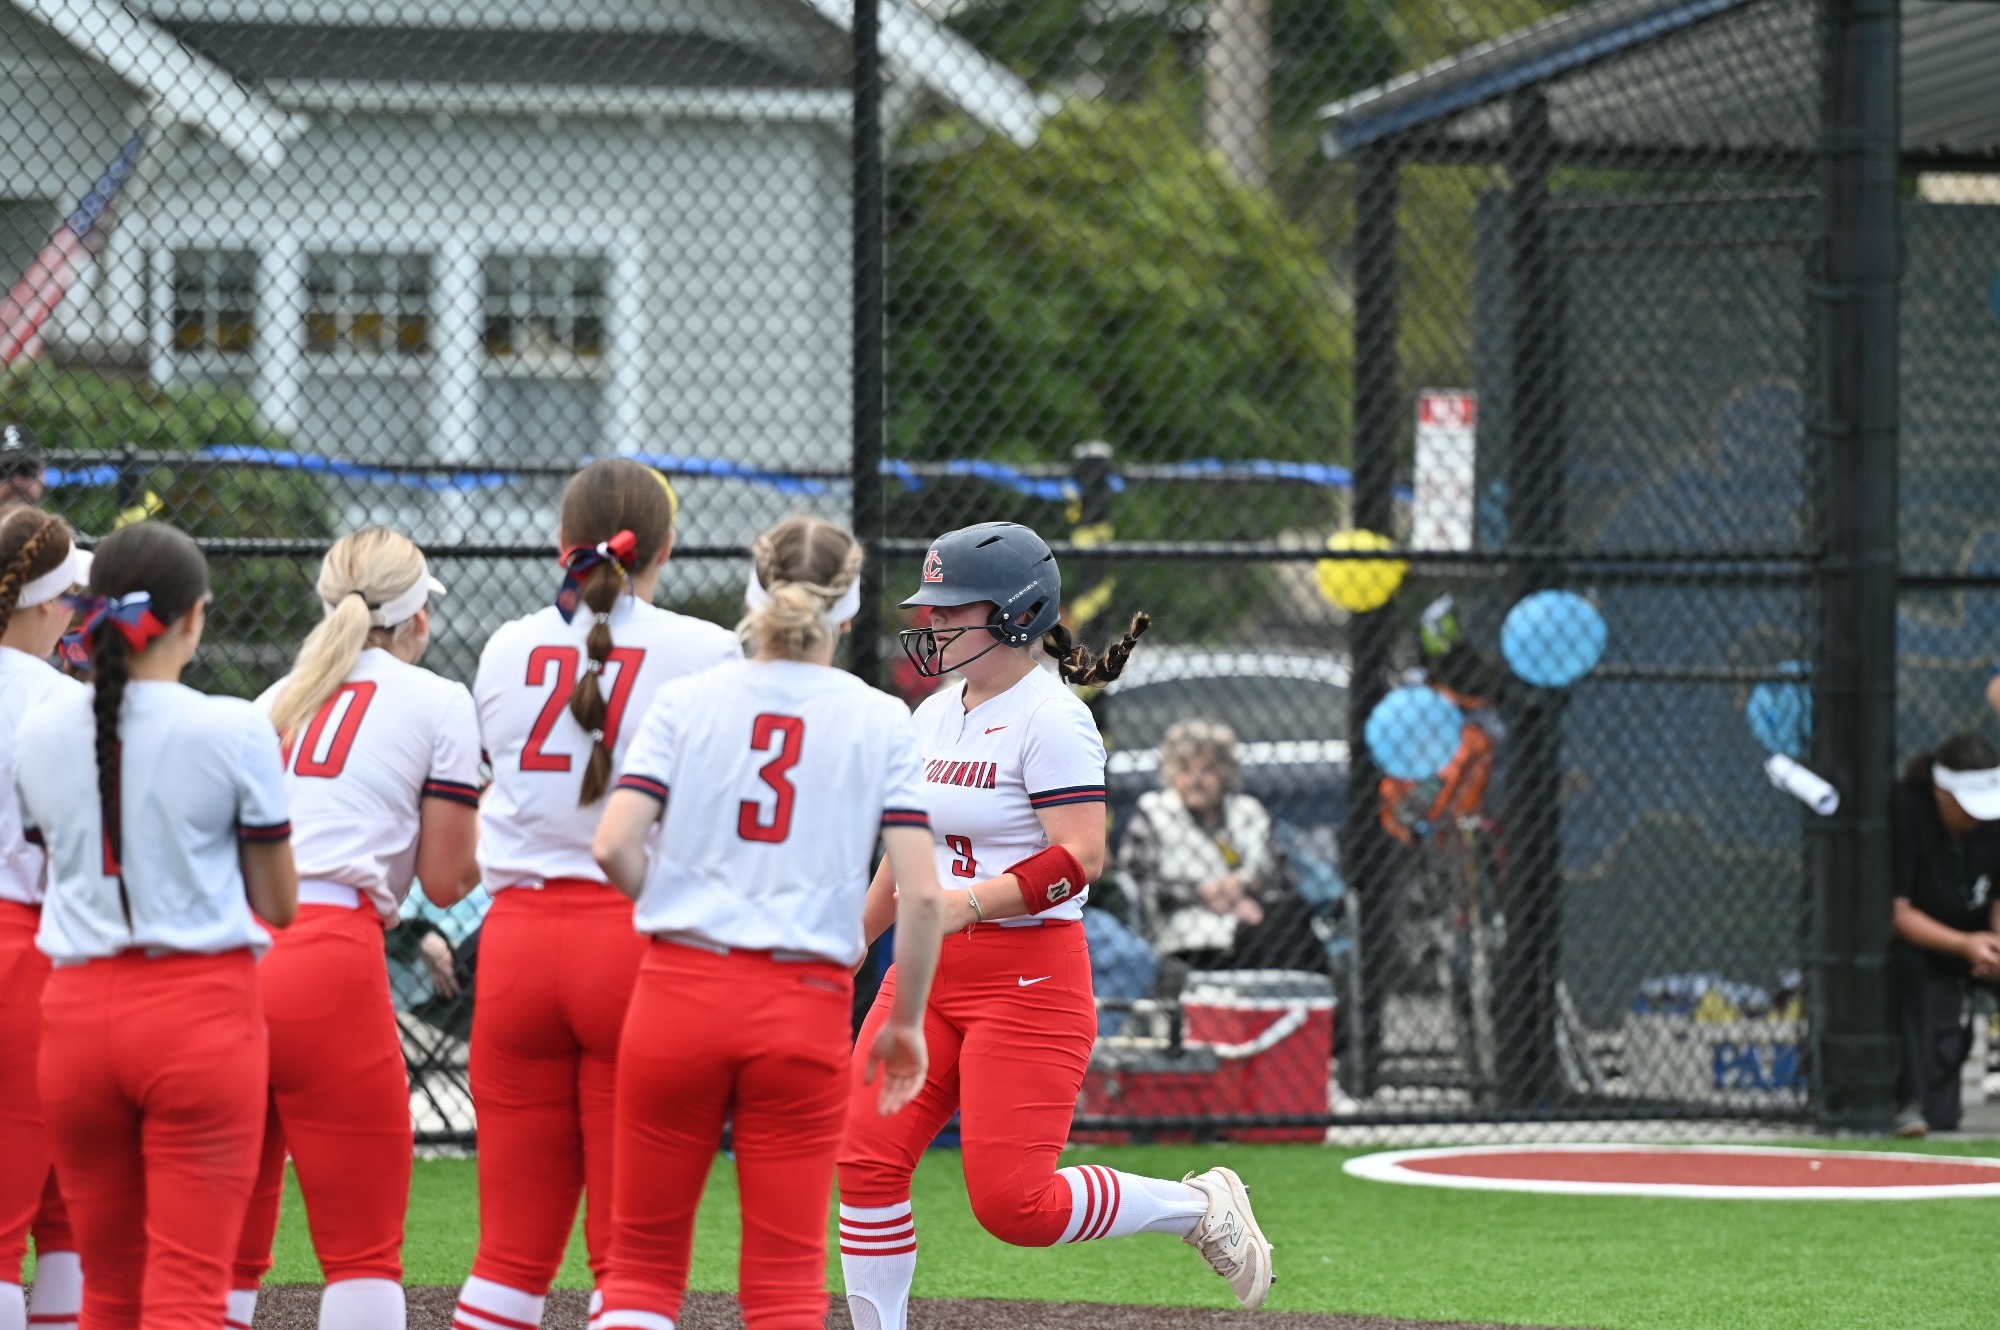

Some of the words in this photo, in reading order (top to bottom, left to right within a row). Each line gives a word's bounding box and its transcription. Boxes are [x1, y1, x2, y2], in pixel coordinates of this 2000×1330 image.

[519, 645, 646, 772] 27
[738, 713, 805, 843] 3
[924, 759, 997, 789] COLUMBIA
[945, 834, 977, 879] 9
